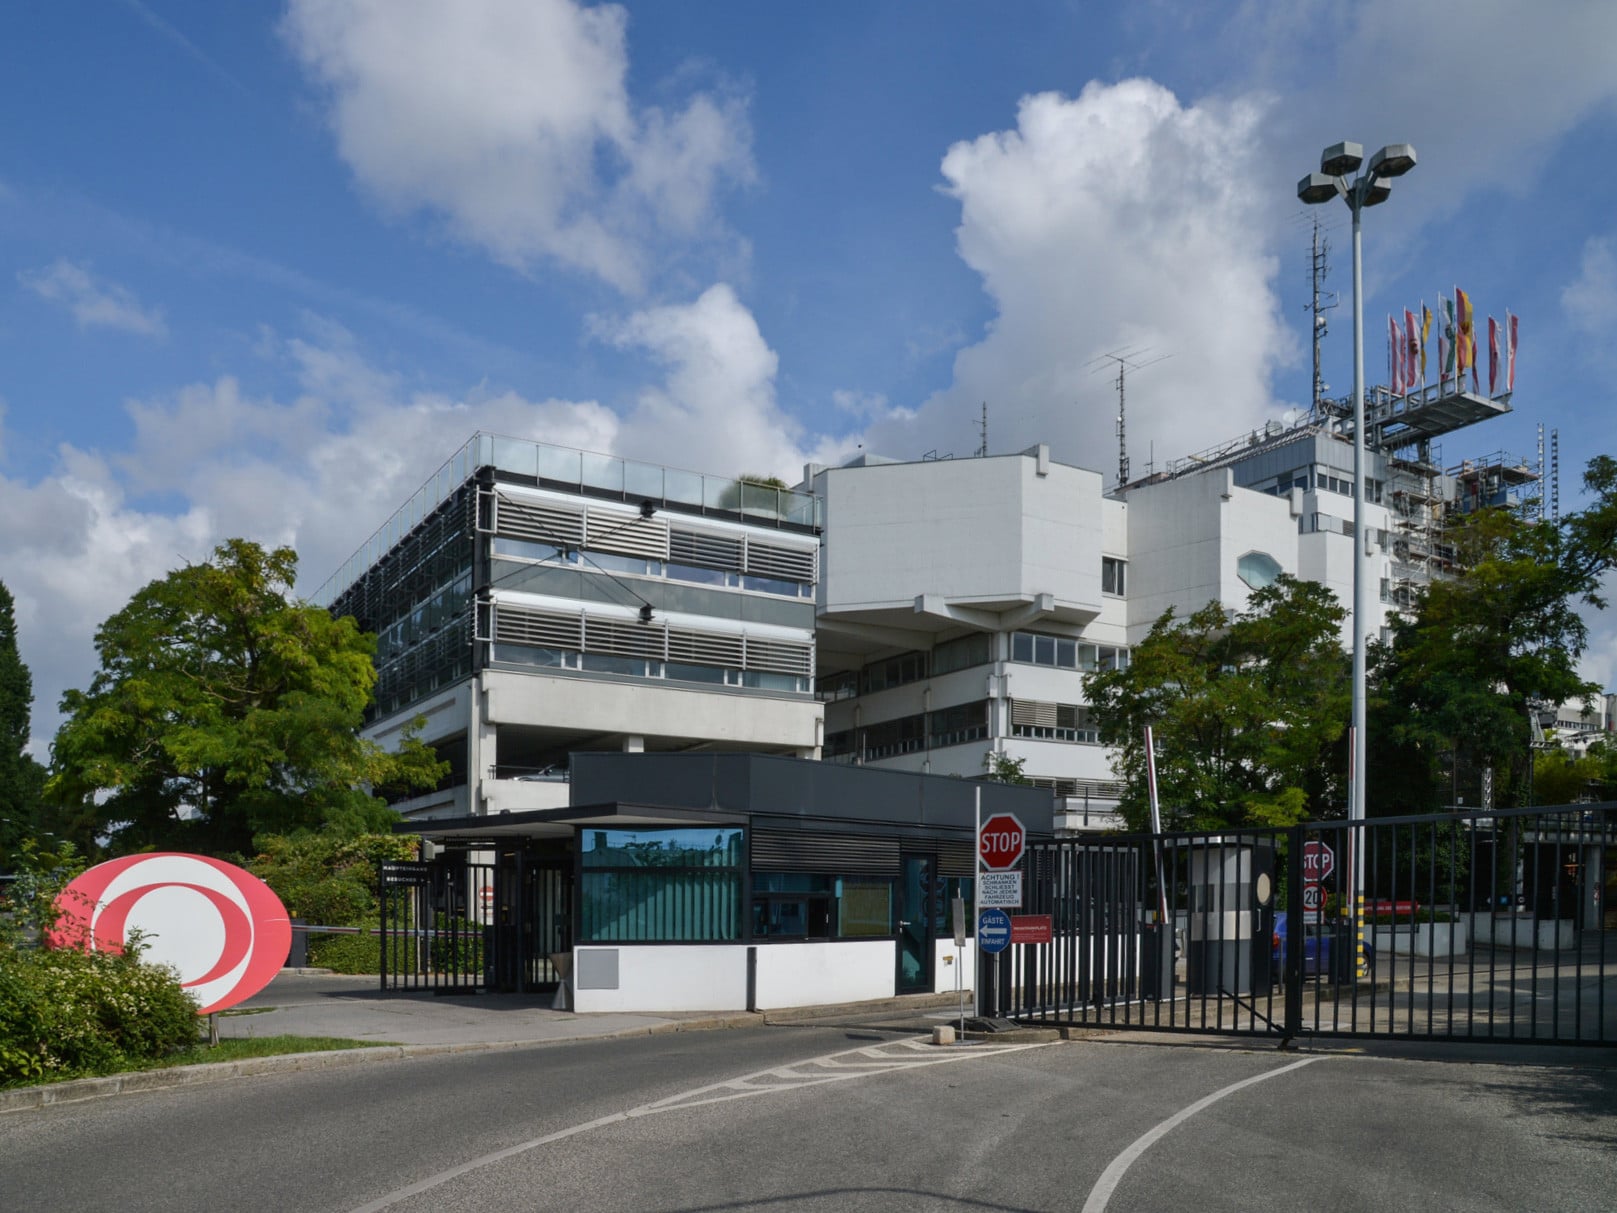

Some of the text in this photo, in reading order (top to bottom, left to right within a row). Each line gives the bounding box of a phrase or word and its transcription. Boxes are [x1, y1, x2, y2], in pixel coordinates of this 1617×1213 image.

[981, 831, 1020, 853] STOP
[1305, 890, 1319, 905] 20
[982, 915, 1005, 925] GÄSTE
